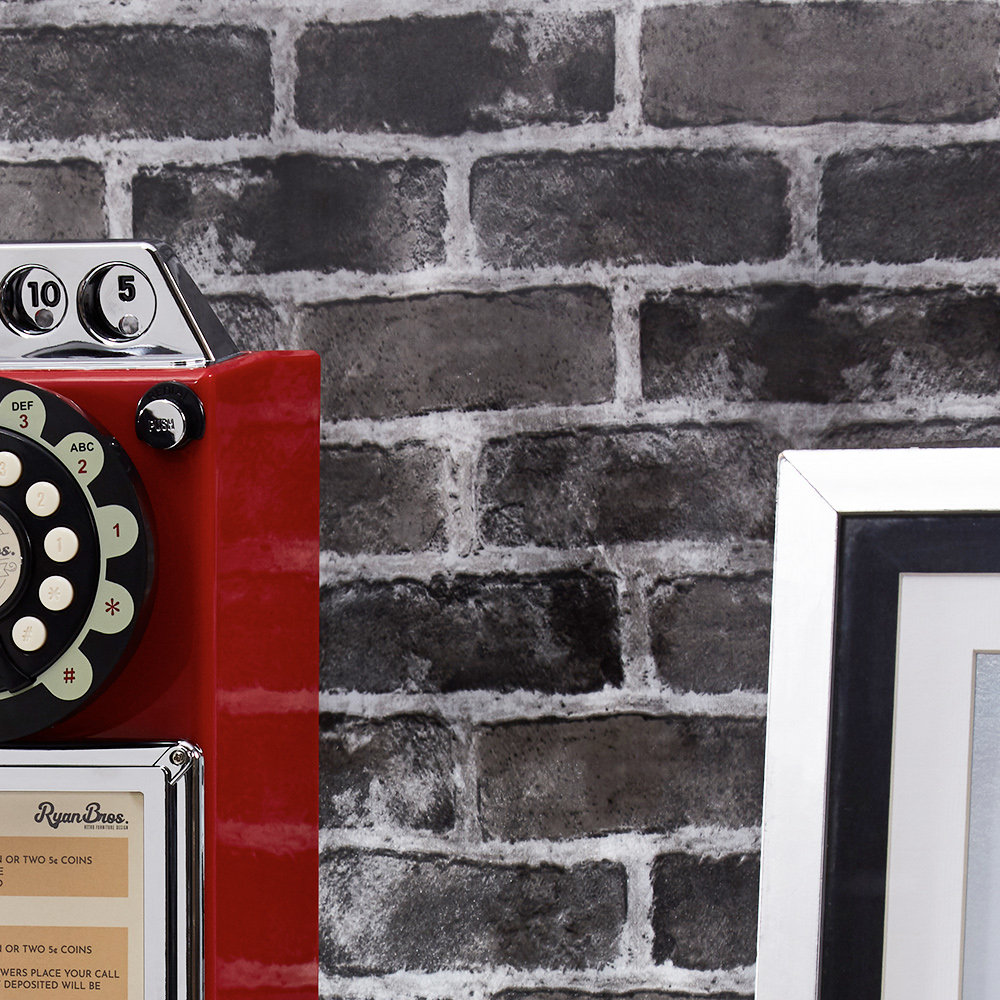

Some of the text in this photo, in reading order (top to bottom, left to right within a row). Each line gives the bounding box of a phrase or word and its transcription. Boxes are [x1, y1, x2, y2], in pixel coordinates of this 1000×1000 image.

[27, 280, 61, 307] 10
[118, 275, 136, 302] 5
[12, 401, 34, 411] DEF
[19, 414, 28, 428] 3
[149, 418, 175, 432] PUSH
[70, 442, 94, 452] ABC
[0, 462, 7, 476] 3
[78, 460, 87, 474] 2
[37, 492, 44, 506] 2
[113, 523, 120, 537] 1
[5, 855, 20, 864] OR
[23, 856, 45, 864] TWO
[61, 856, 93, 865] COINS
[5, 945, 19, 953] OR
[22, 945, 45, 953] TWO
[60, 945, 92, 954] COINS
[31, 969, 61, 977] PLACE
[64, 969, 92, 978] YOUR
[95, 970, 120, 979] CALL
[4, 980, 59, 989] DEPOSITED
[62, 981, 86, 990] WILL
[89, 982, 101, 990] BE
